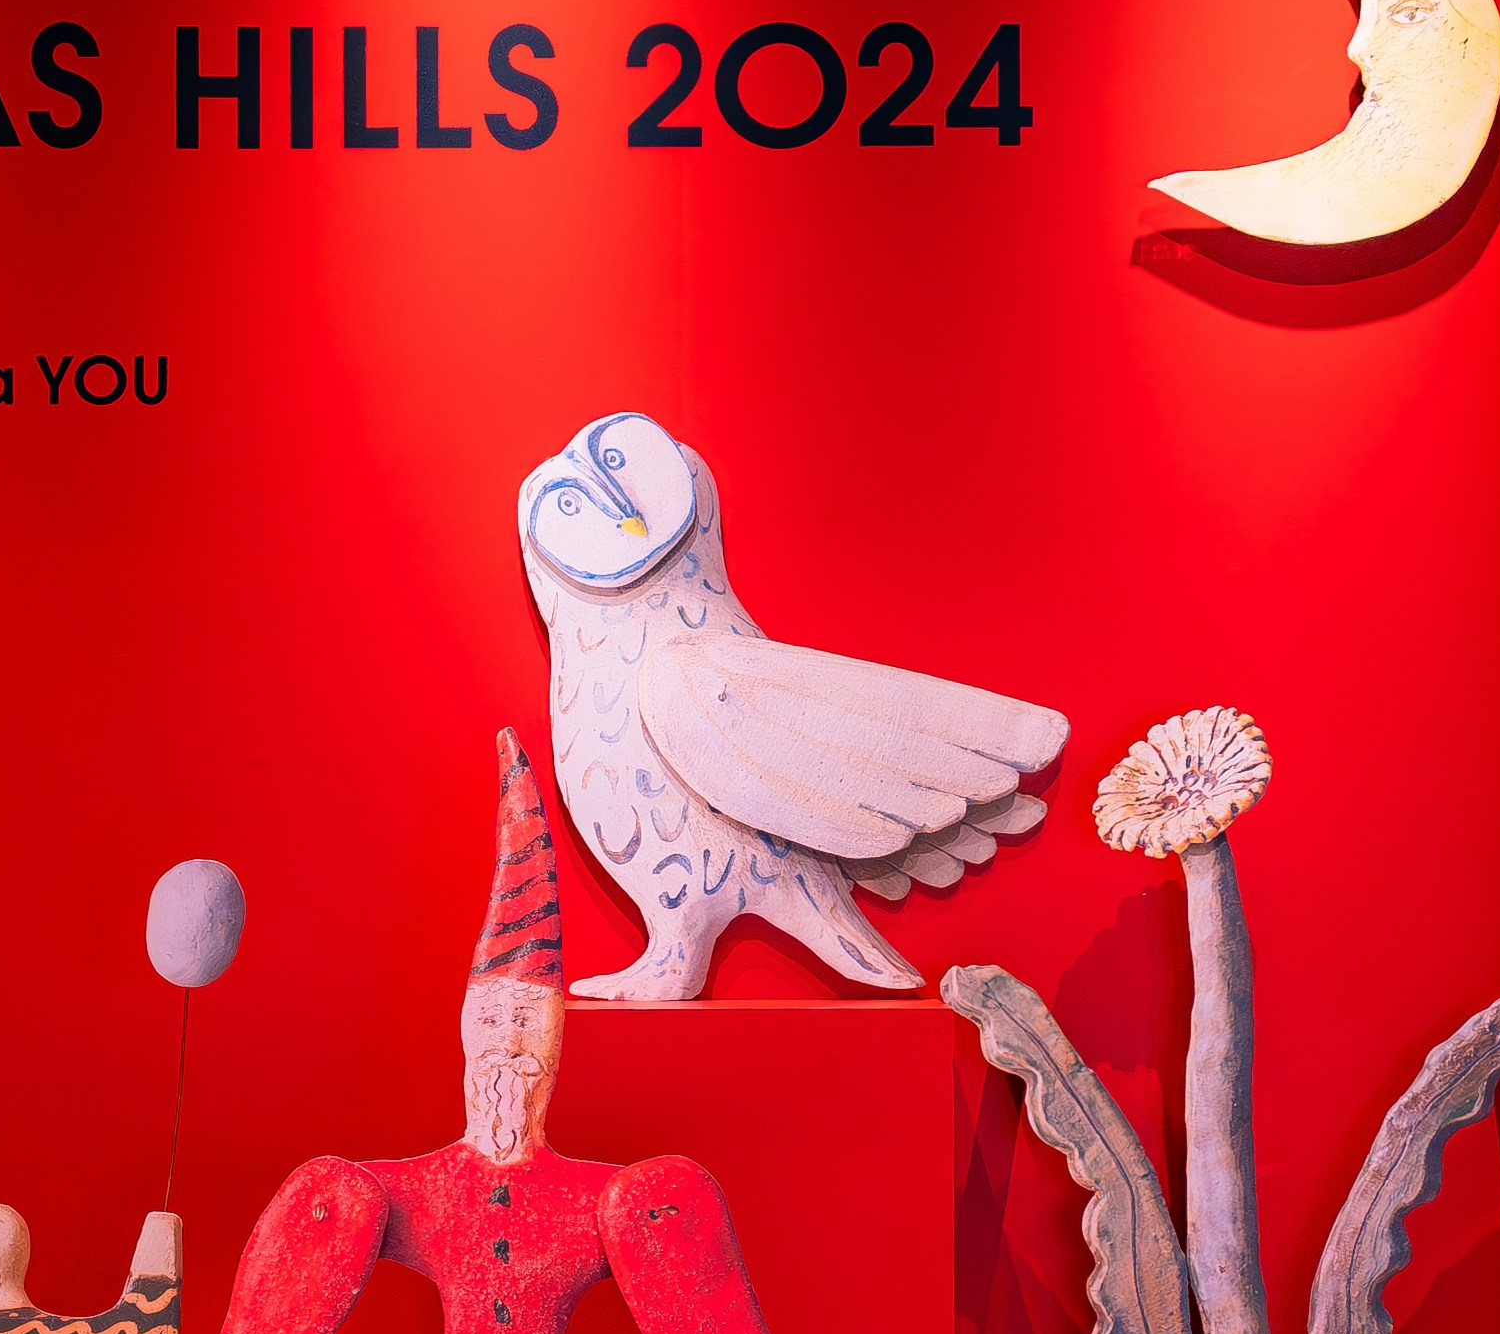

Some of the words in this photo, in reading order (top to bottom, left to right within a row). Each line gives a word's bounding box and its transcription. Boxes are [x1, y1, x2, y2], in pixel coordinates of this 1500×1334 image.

[174, 25, 559, 150] HILLS
[626, 21, 1034, 150] 2024
[35, 353, 169, 407] YOU
